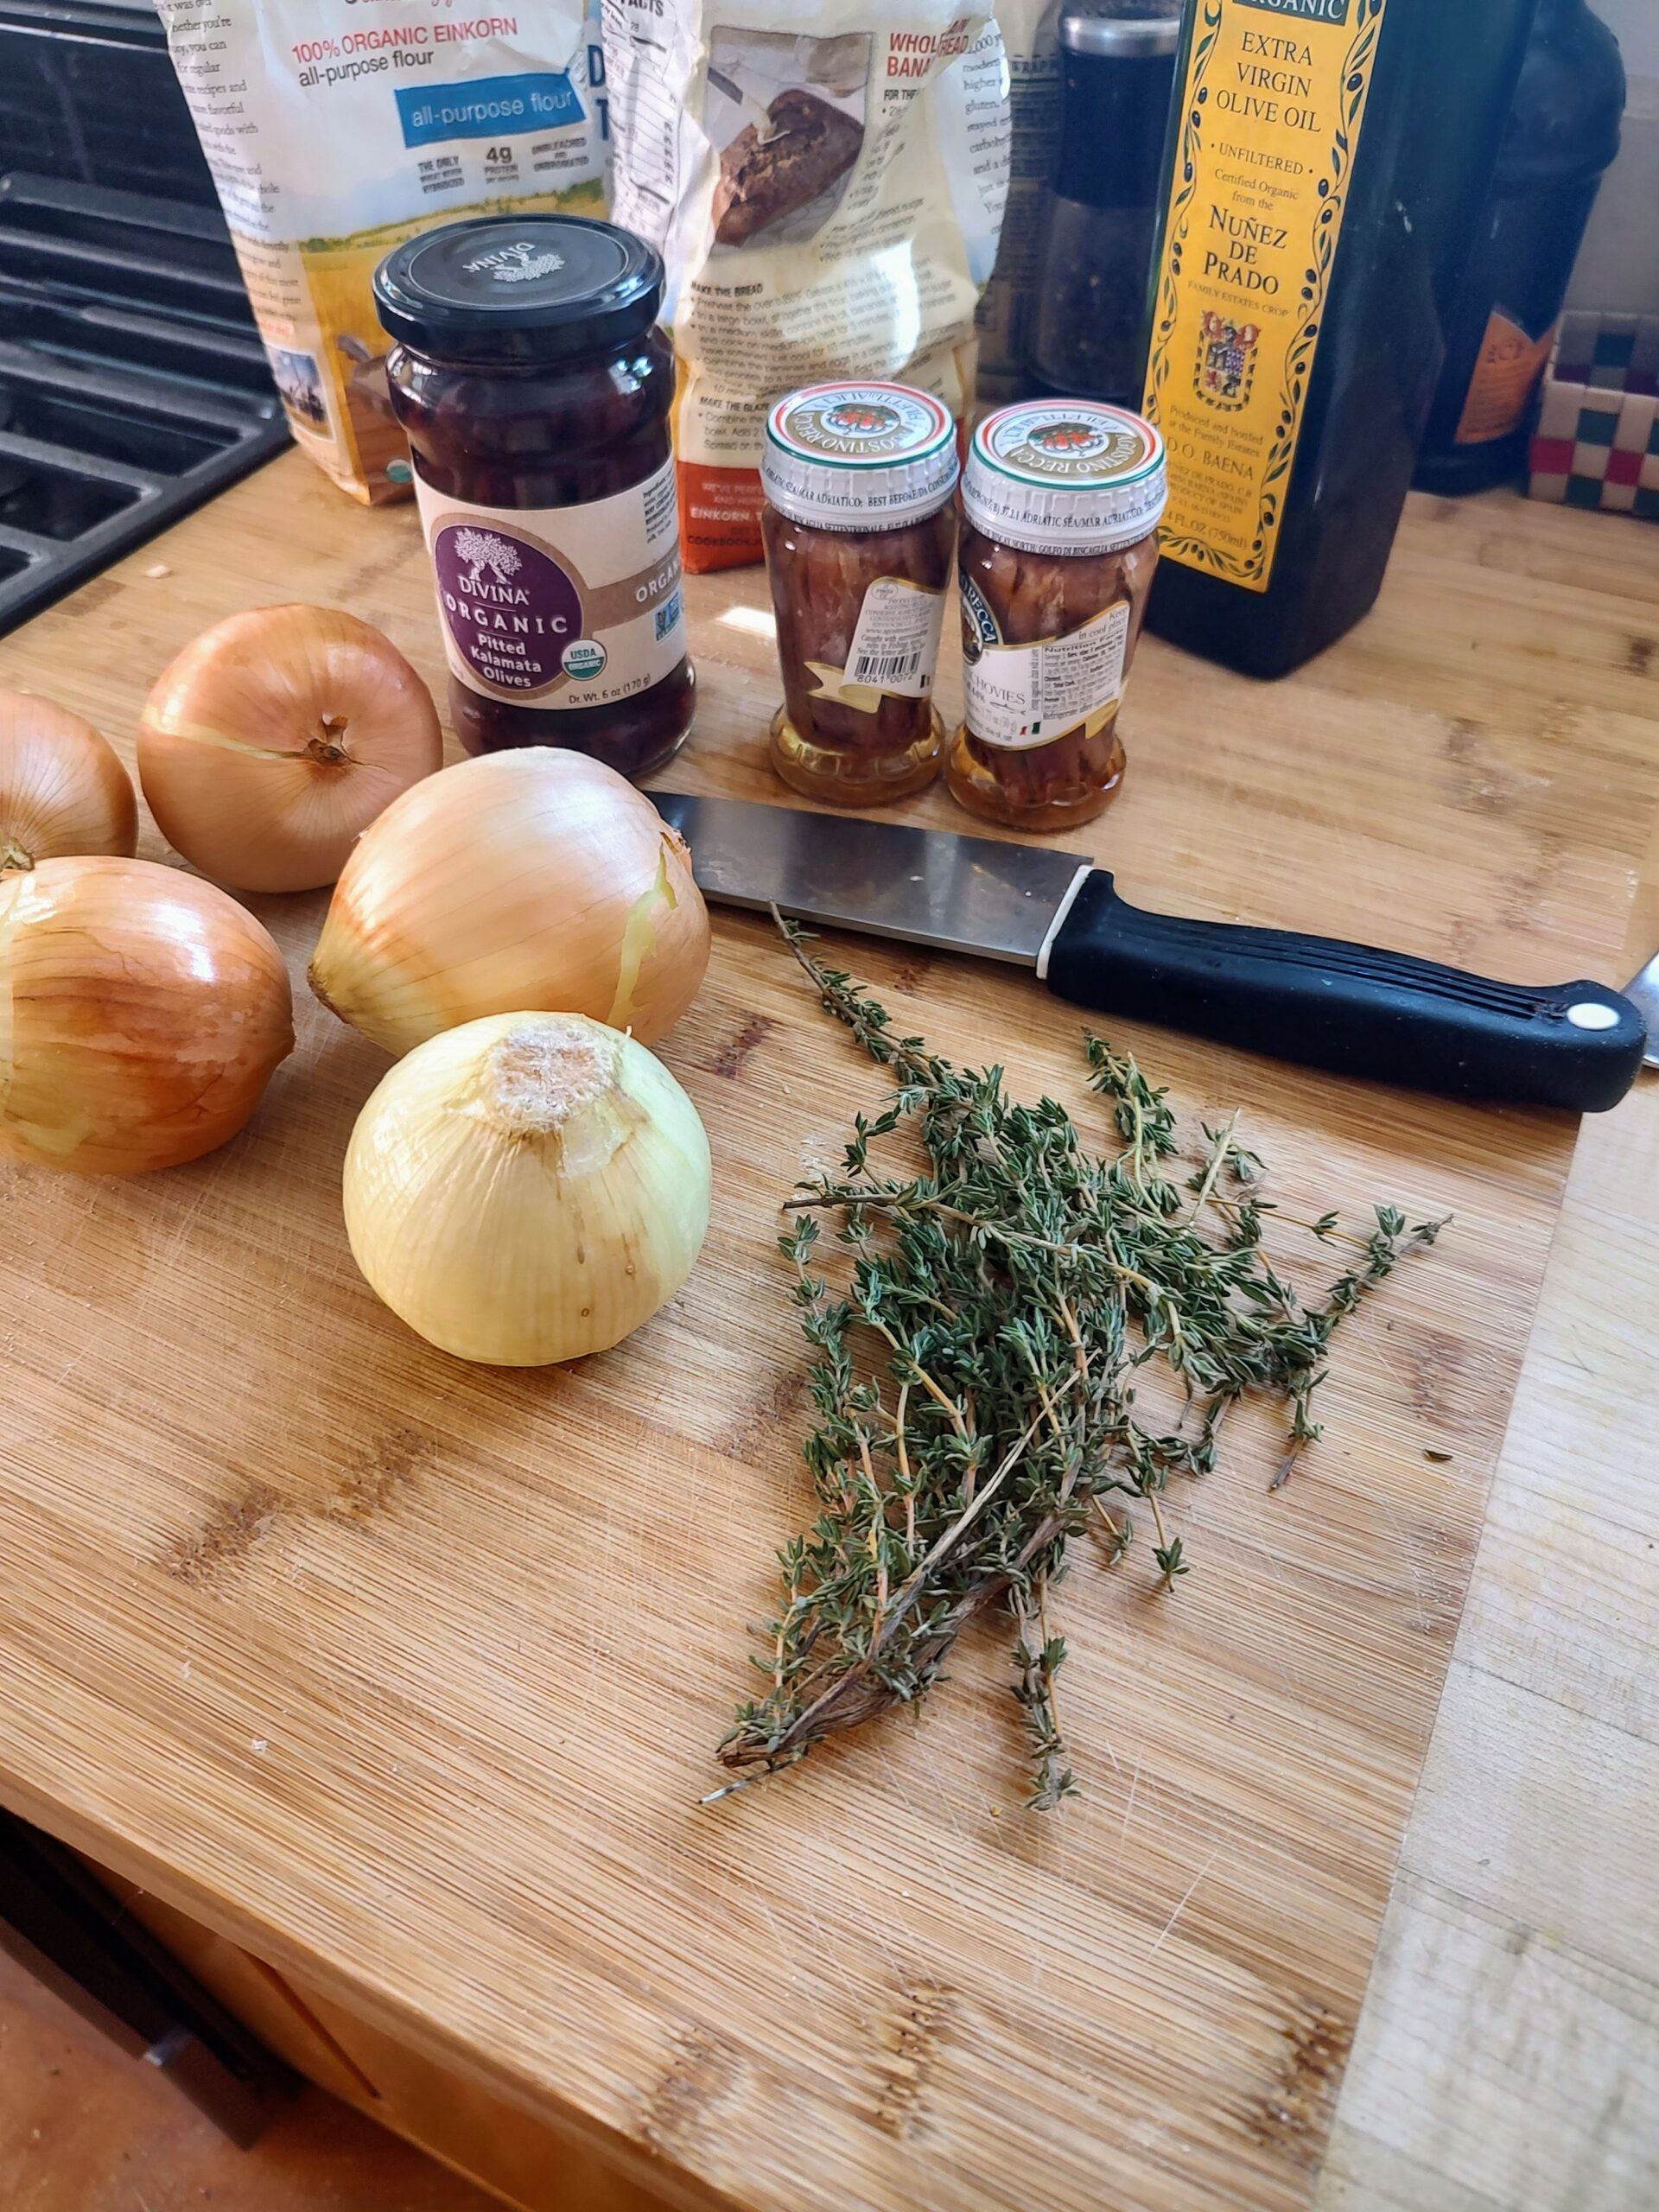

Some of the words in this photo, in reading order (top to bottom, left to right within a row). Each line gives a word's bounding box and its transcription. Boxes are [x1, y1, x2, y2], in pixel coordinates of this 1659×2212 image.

[292, 39, 340, 63] 100%
[342, 27, 429, 54] ORGANIC
[434, 17, 518, 42] EINKORN
[1241, 31, 1313, 67] EXTRA
[299, 55, 388, 86] all-purpose
[393, 50, 435, 67] flour
[1236, 61, 1312, 98] VIRGIN
[412, 99, 524, 128] all-purpose
[531, 91, 572, 114] flour
[1217, 90, 1279, 123] OLIVE
[1284, 106, 1321, 132] OIL
[486, 147, 512, 163] 4g
[1219, 143, 1304, 175] UNFILTERED
[1215, 168, 1257, 189] Certified
[1258, 181, 1300, 200] Organic
[1232, 190, 1255, 207] from
[1258, 199, 1274, 211] the
[461, 242, 536, 272] DIVINA
[1229, 240, 1258, 265] DE
[1203, 251, 1279, 295] PRADO
[1188, 280, 1220, 298] FAMILY
[1221, 292, 1260, 310] ESTATES
[1262, 304, 1289, 317] CROP
[700, 397, 722, 409] MAKE
[726, 401, 741, 411] THE
[1194, 428, 1224, 448] Family
[1211, 422, 1229, 434] and
[1010, 448, 1071, 474] RECCA
[1076, 435, 1137, 473] AGOSTINO
[1203, 450, 1254, 480] BAENA
[690, 507, 749, 522] EINKORN
[868, 496, 887, 507] BEST
[1020, 511, 1061, 527] ADRIATIC
[458, 575, 530, 605] DIVINA
[444, 594, 568, 634] ORGANIC
[967, 587, 997, 641] RECCA
[478, 632, 526, 656] Pitted
[1078, 632, 1087, 640] in
[1089, 625, 1106, 639] cool
[471, 646, 543, 673] Kalamata
[570, 648, 597, 660] USDA
[1045, 641, 1096, 653] Nutrition
[483, 666, 532, 688] Olives
[568, 658, 601, 671] ORGANIC
[856, 675, 885, 684] 8041
[569, 694, 582, 705] Dr.
[583, 691, 599, 702] Wt.
[602, 690, 608, 699] 6
[610, 689, 620, 697] oz
